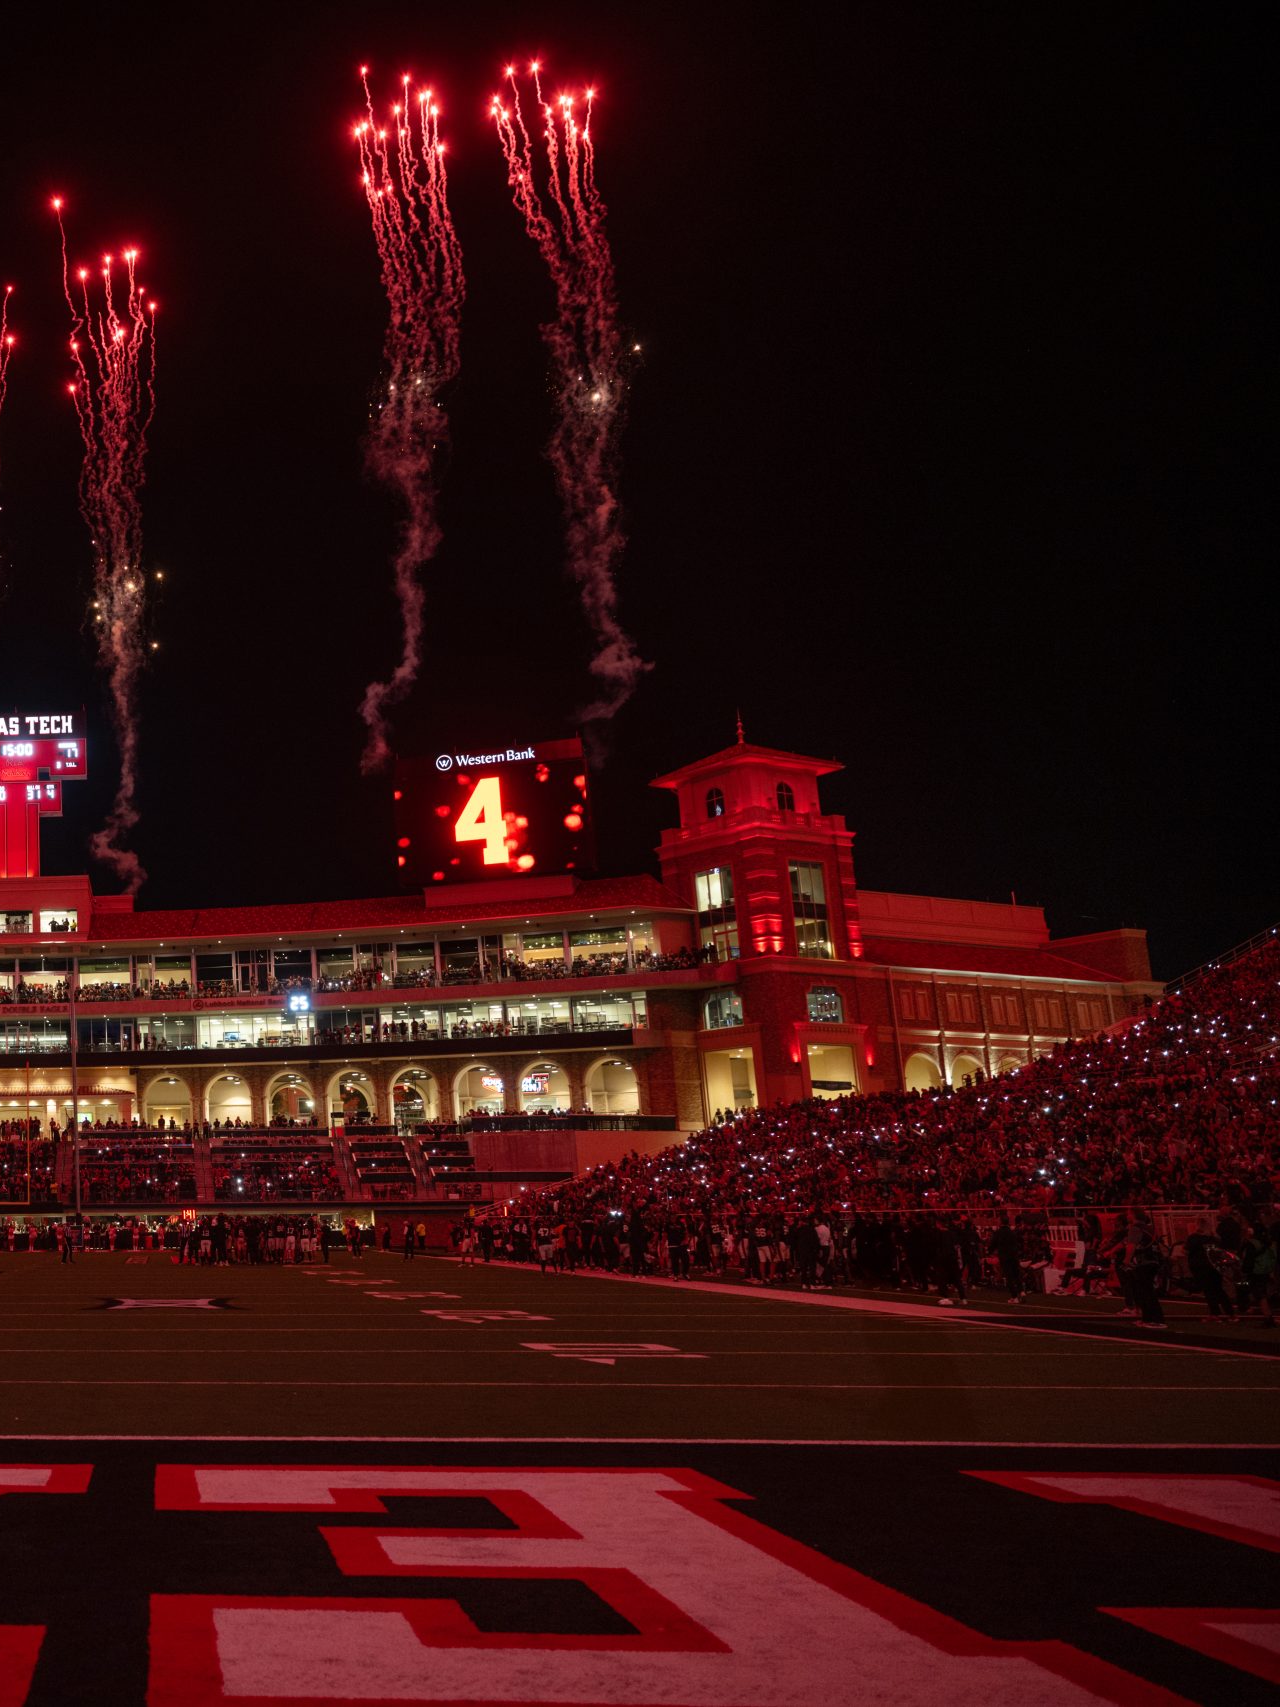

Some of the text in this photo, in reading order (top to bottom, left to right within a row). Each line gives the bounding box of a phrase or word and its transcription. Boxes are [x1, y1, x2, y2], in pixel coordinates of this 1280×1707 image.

[25, 715, 73, 734] TECH
[2, 743, 33, 756] 15:00
[67, 748, 78, 758] 17
[455, 754, 505, 767] Western
[506, 747, 535, 761] Bank
[47, 789, 55, 799] 4
[455, 777, 509, 865] 4
[3, 1006, 37, 1014] DOUBLE
[290, 996, 309, 1011] 25
